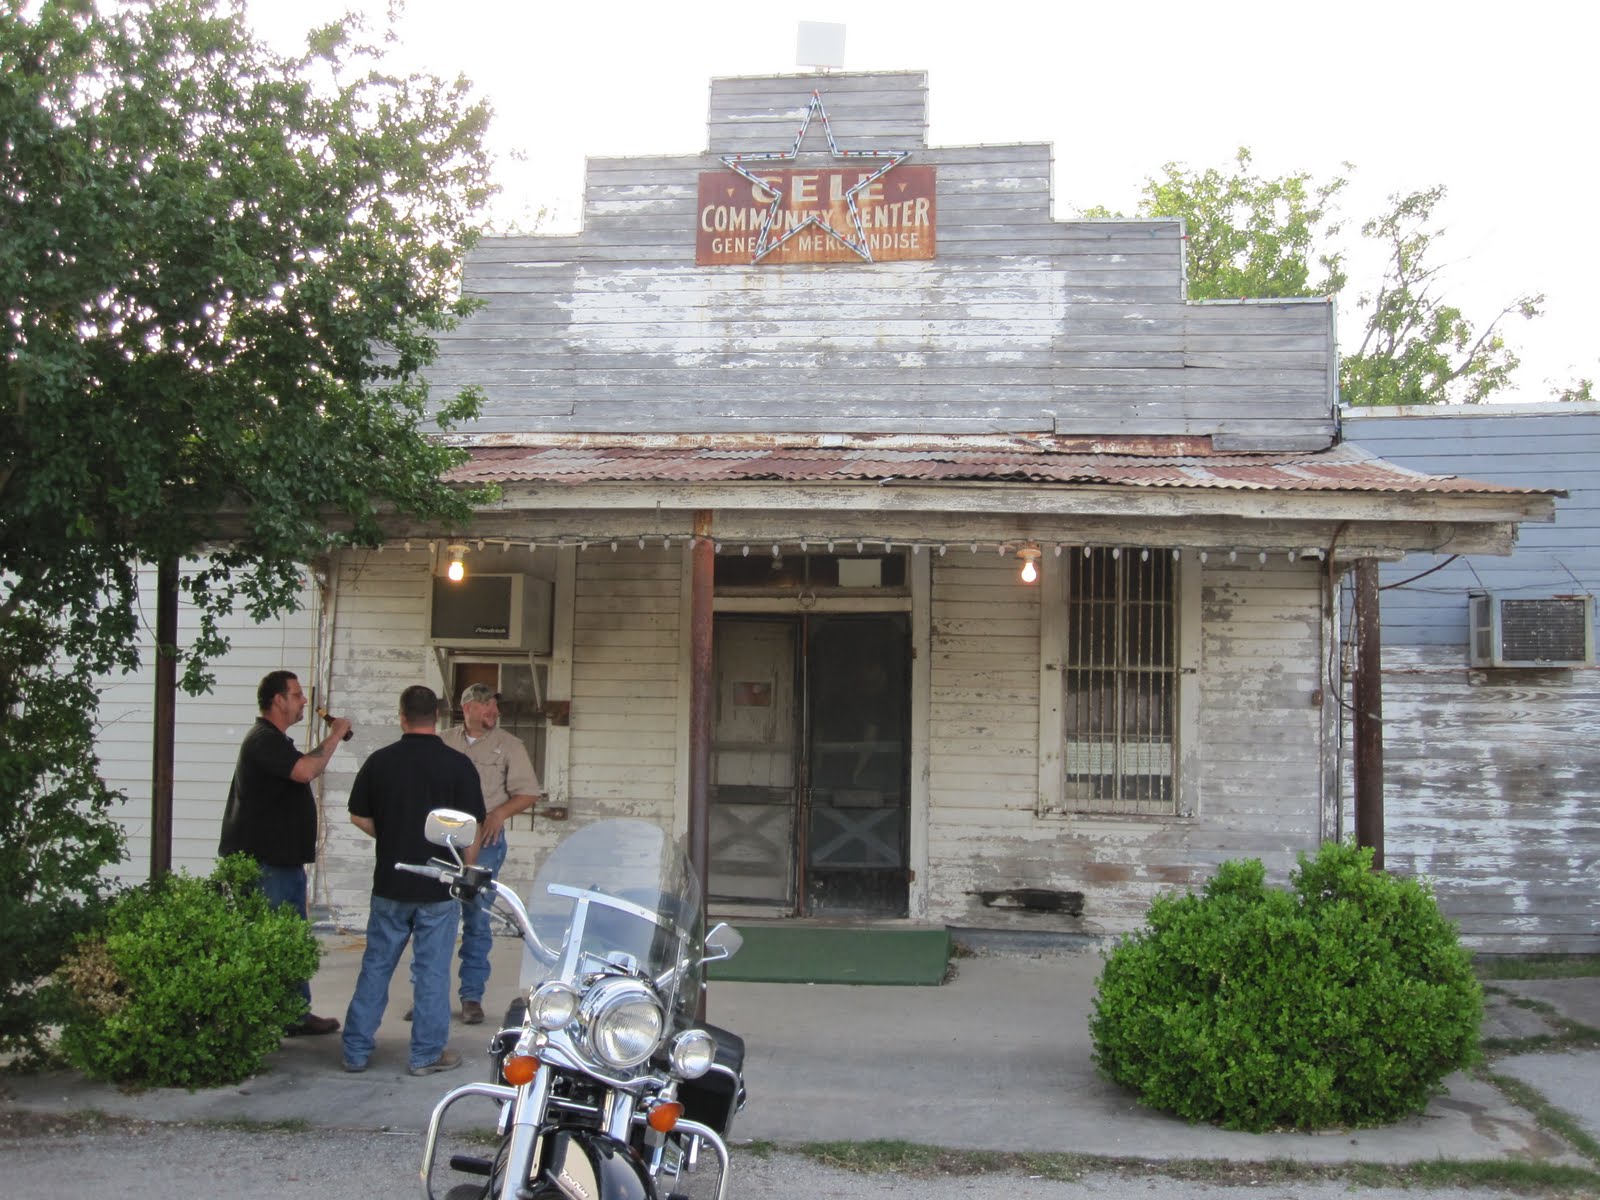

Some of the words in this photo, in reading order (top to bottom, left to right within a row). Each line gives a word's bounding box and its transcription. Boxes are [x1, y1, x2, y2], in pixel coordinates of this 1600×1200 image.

[752, 174, 885, 203] CELE
[845, 198, 930, 228] CENTER
[712, 238, 790, 254] GENEAL
